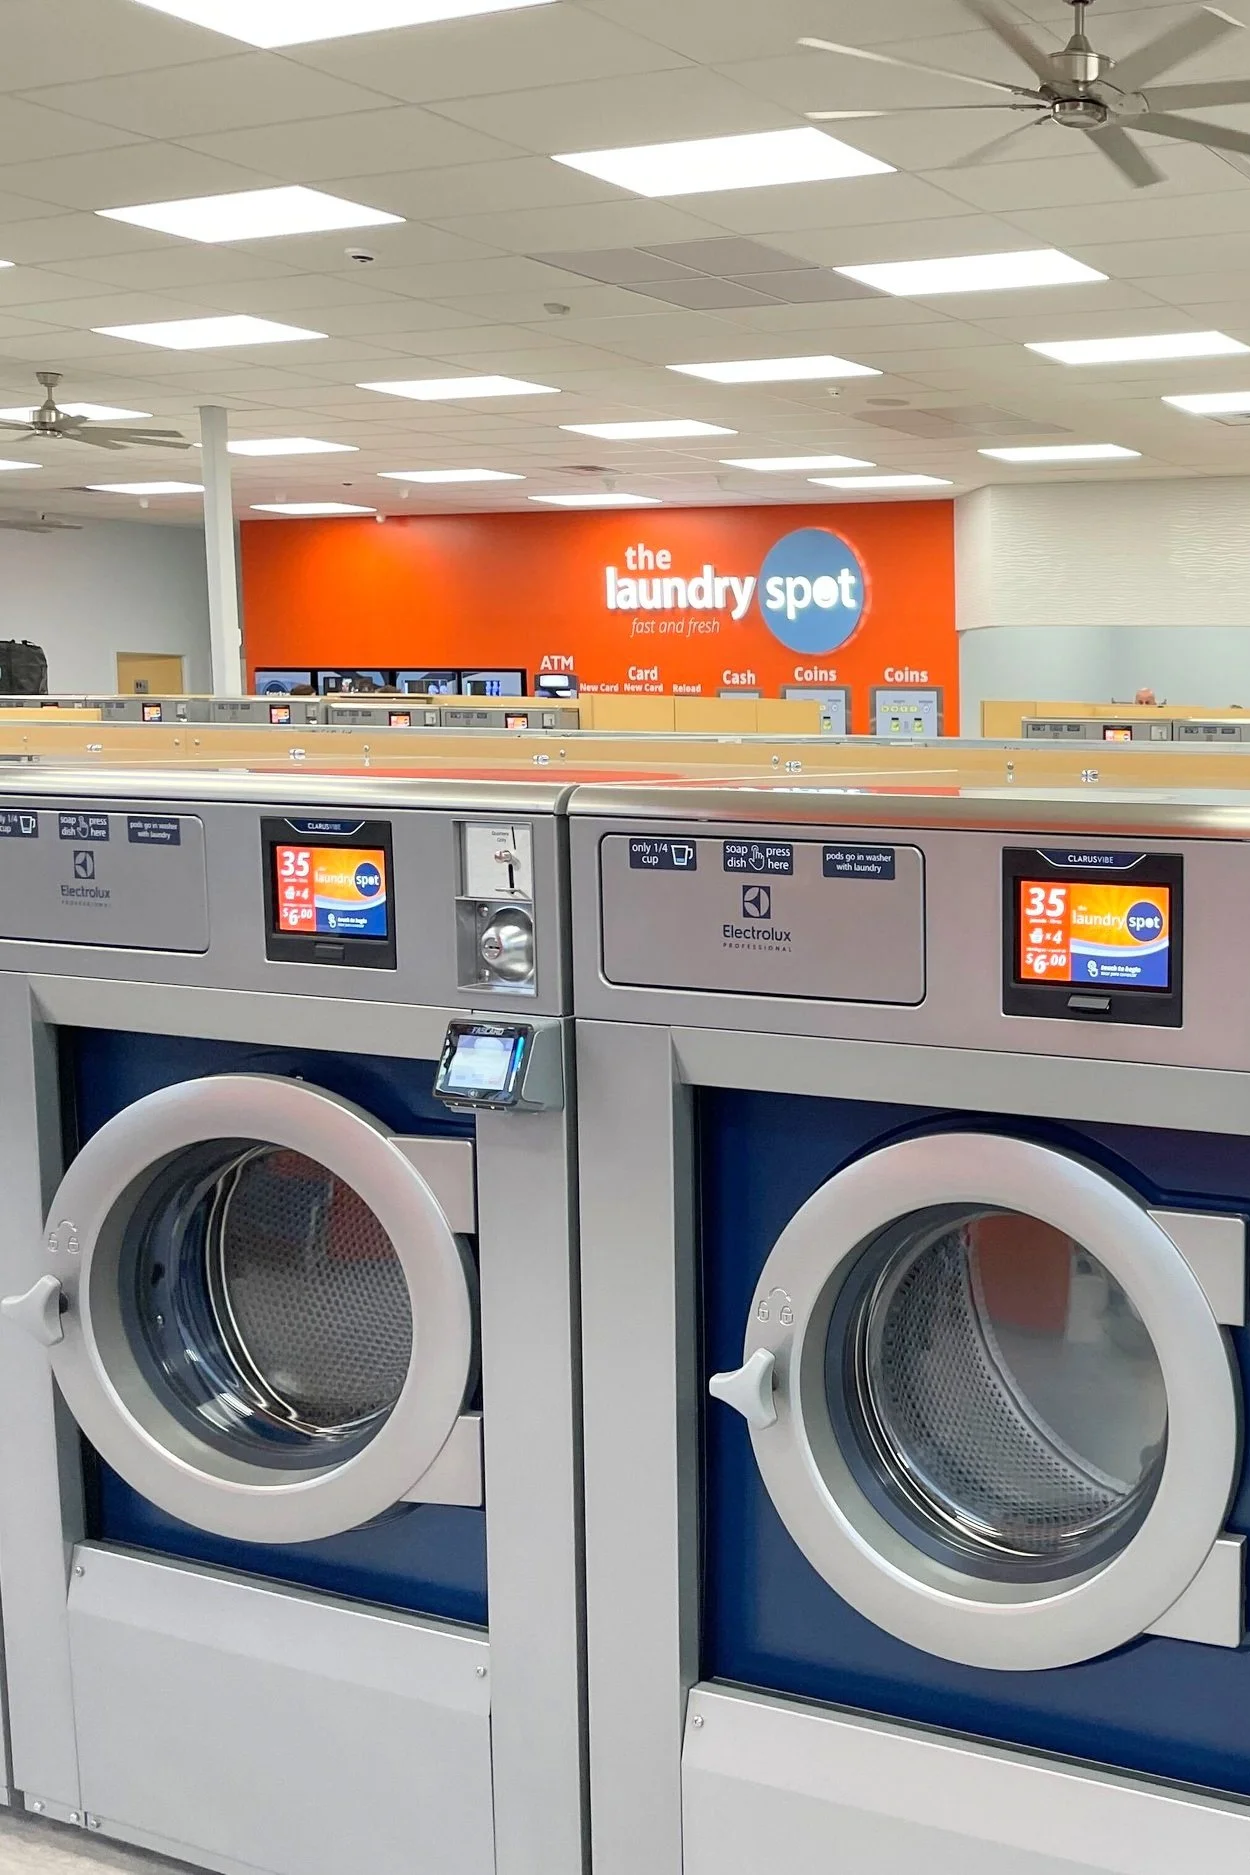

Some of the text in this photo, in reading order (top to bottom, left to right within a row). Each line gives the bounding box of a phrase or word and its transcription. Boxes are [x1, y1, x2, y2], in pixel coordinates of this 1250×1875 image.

[625, 543, 672, 571] the
[606, 565, 856, 620] laundry spot
[630, 617, 720, 638] fast and fresh
[540, 655, 574, 671] ATM
[628, 666, 659, 681] Card
[722, 670, 756, 686] Cash
[794, 666, 837, 682] Coins
[884, 667, 928, 683] Coins
[580, 683, 619, 692] New Card
[624, 683, 663, 692] New Card
[673, 684, 702, 693] Reload
[60, 816, 107, 827] soap press
[61, 827, 107, 838] dish here
[632, 842, 668, 854] only 1/4
[726, 845, 790, 858] soap press
[280, 851, 311, 877] 35
[642, 855, 659, 866] cup
[727, 857, 789, 870] dish here
[826, 852, 891, 863] pods go in washer
[1067, 854, 1114, 864] CLARUSVIBE
[836, 863, 882, 874] with laundry
[356, 874, 379, 889] spot
[61, 884, 110, 899] Electrolux
[301, 888, 309, 899] 4
[1025, 887, 1067, 918] 35
[283, 908, 312, 926] $6.00
[1072, 909, 1160, 931] laundry spot
[723, 924, 791, 942] Electrolux
[1052, 930, 1062, 944] 4
[723, 942, 792, 953] PROFESSIONAL
[1025, 953, 1067, 974] $6.00
